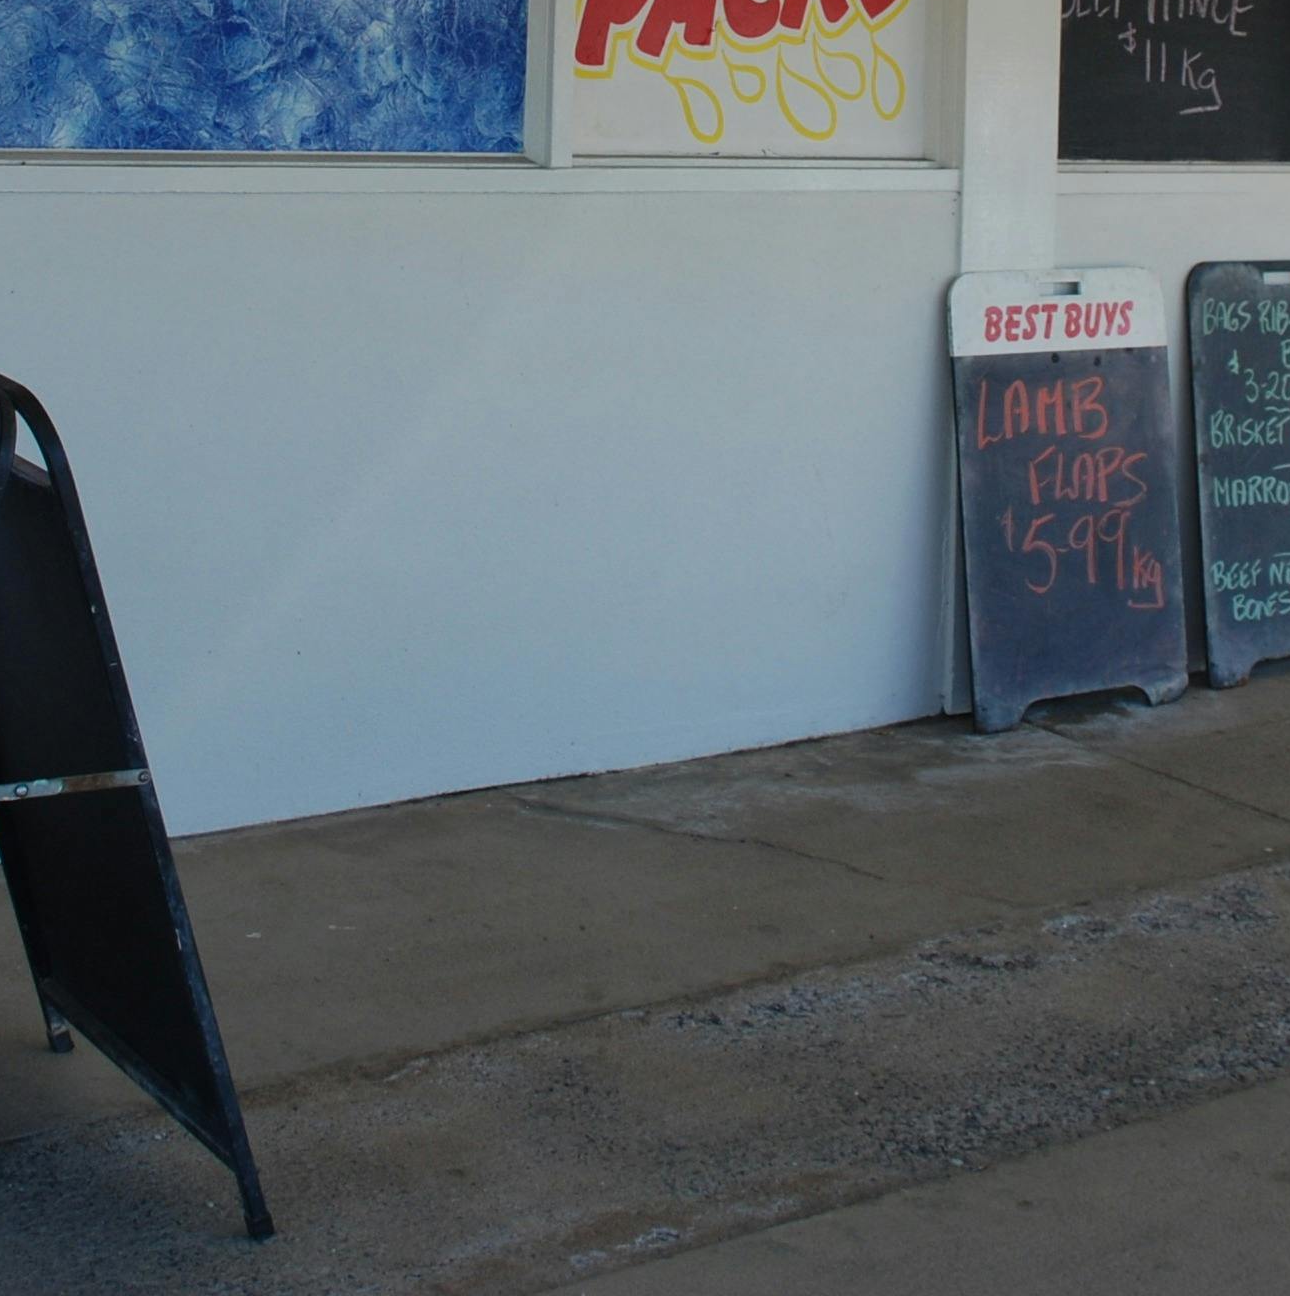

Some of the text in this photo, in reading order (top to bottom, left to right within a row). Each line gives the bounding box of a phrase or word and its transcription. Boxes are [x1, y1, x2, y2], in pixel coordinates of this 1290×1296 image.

[983, 299, 1134, 343] BEST BUYS
[1202, 296, 1252, 336] BAGS
[977, 375, 1109, 451] LAMB
[1210, 408, 1289, 448] BRISKET
[1029, 444, 1148, 508] FLAPS
[1211, 557, 1263, 592] BEEF
